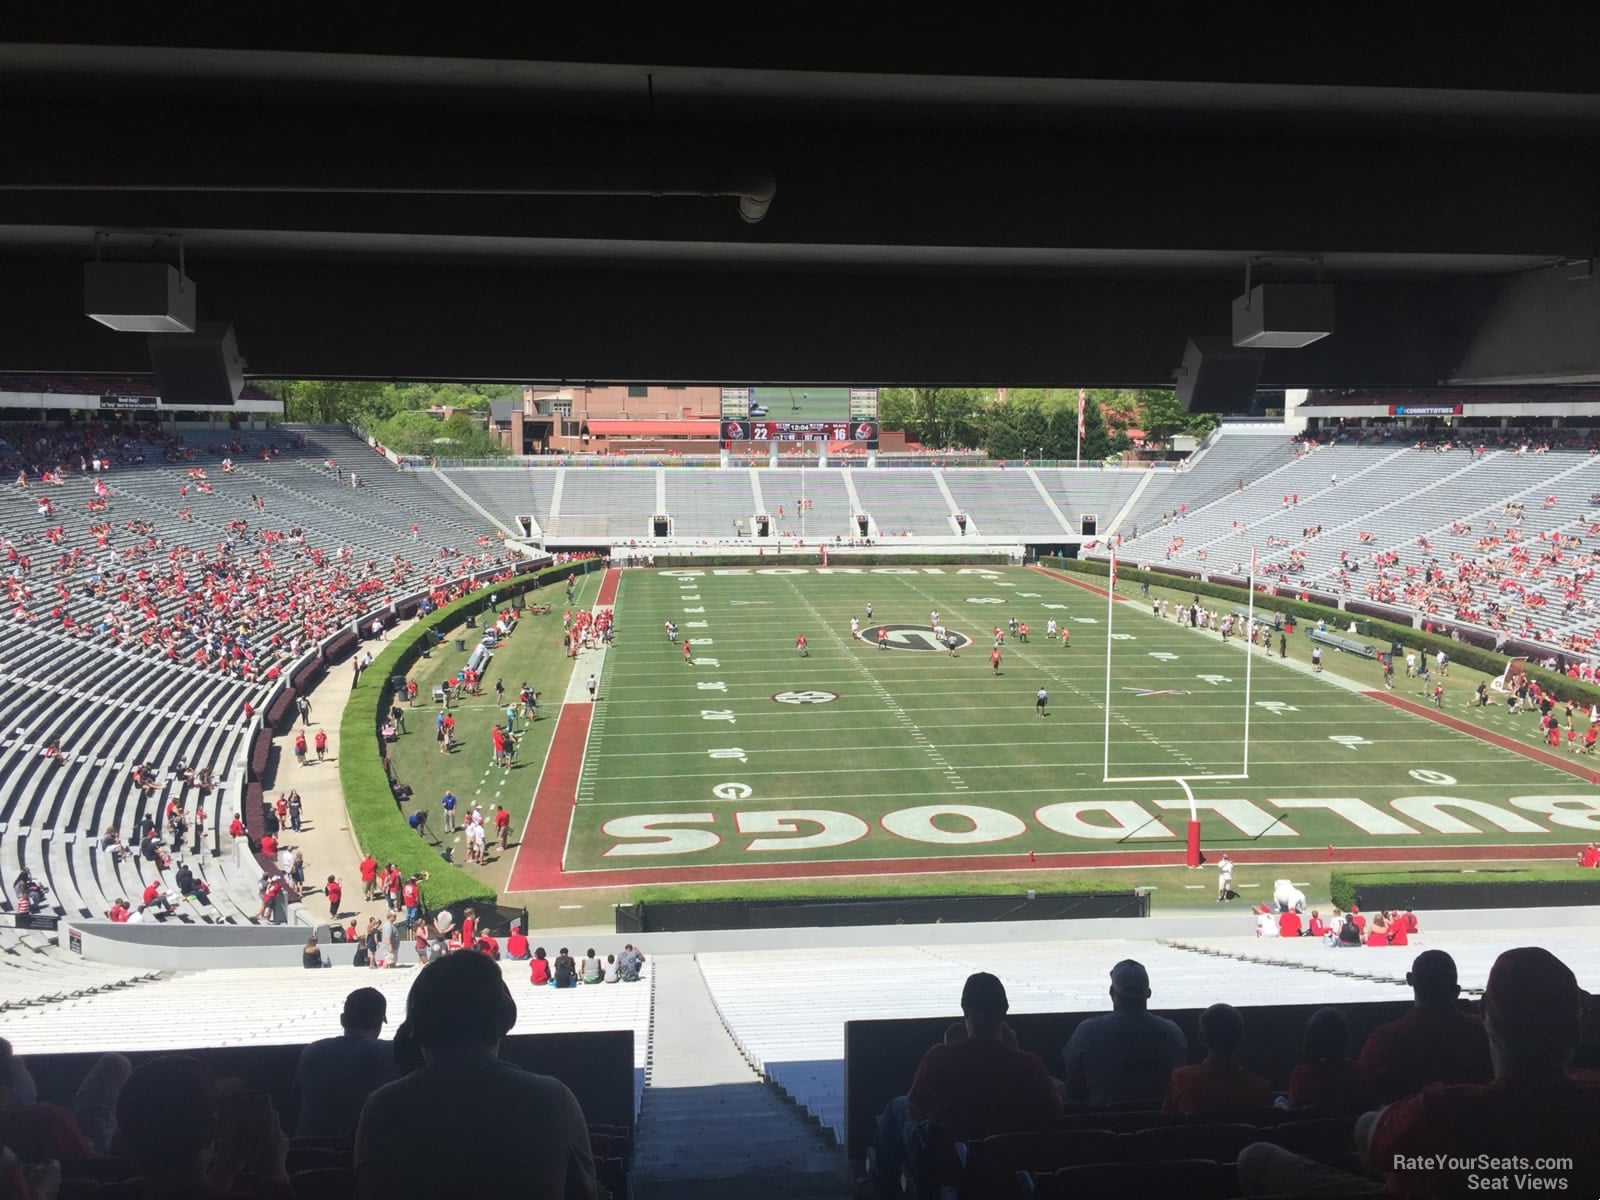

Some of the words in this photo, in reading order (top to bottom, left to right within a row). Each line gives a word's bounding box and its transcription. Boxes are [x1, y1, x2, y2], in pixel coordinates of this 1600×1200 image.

[754, 428, 768, 440] 22
[834, 428, 846, 440] 16
[658, 568, 1005, 577] GEORGIA
[700, 709, 735, 720] 20
[707, 747, 746, 759] 10
[1408, 769, 1457, 785] G
[712, 782, 753, 800] G
[602, 795, 1600, 857] BULLDOGS
